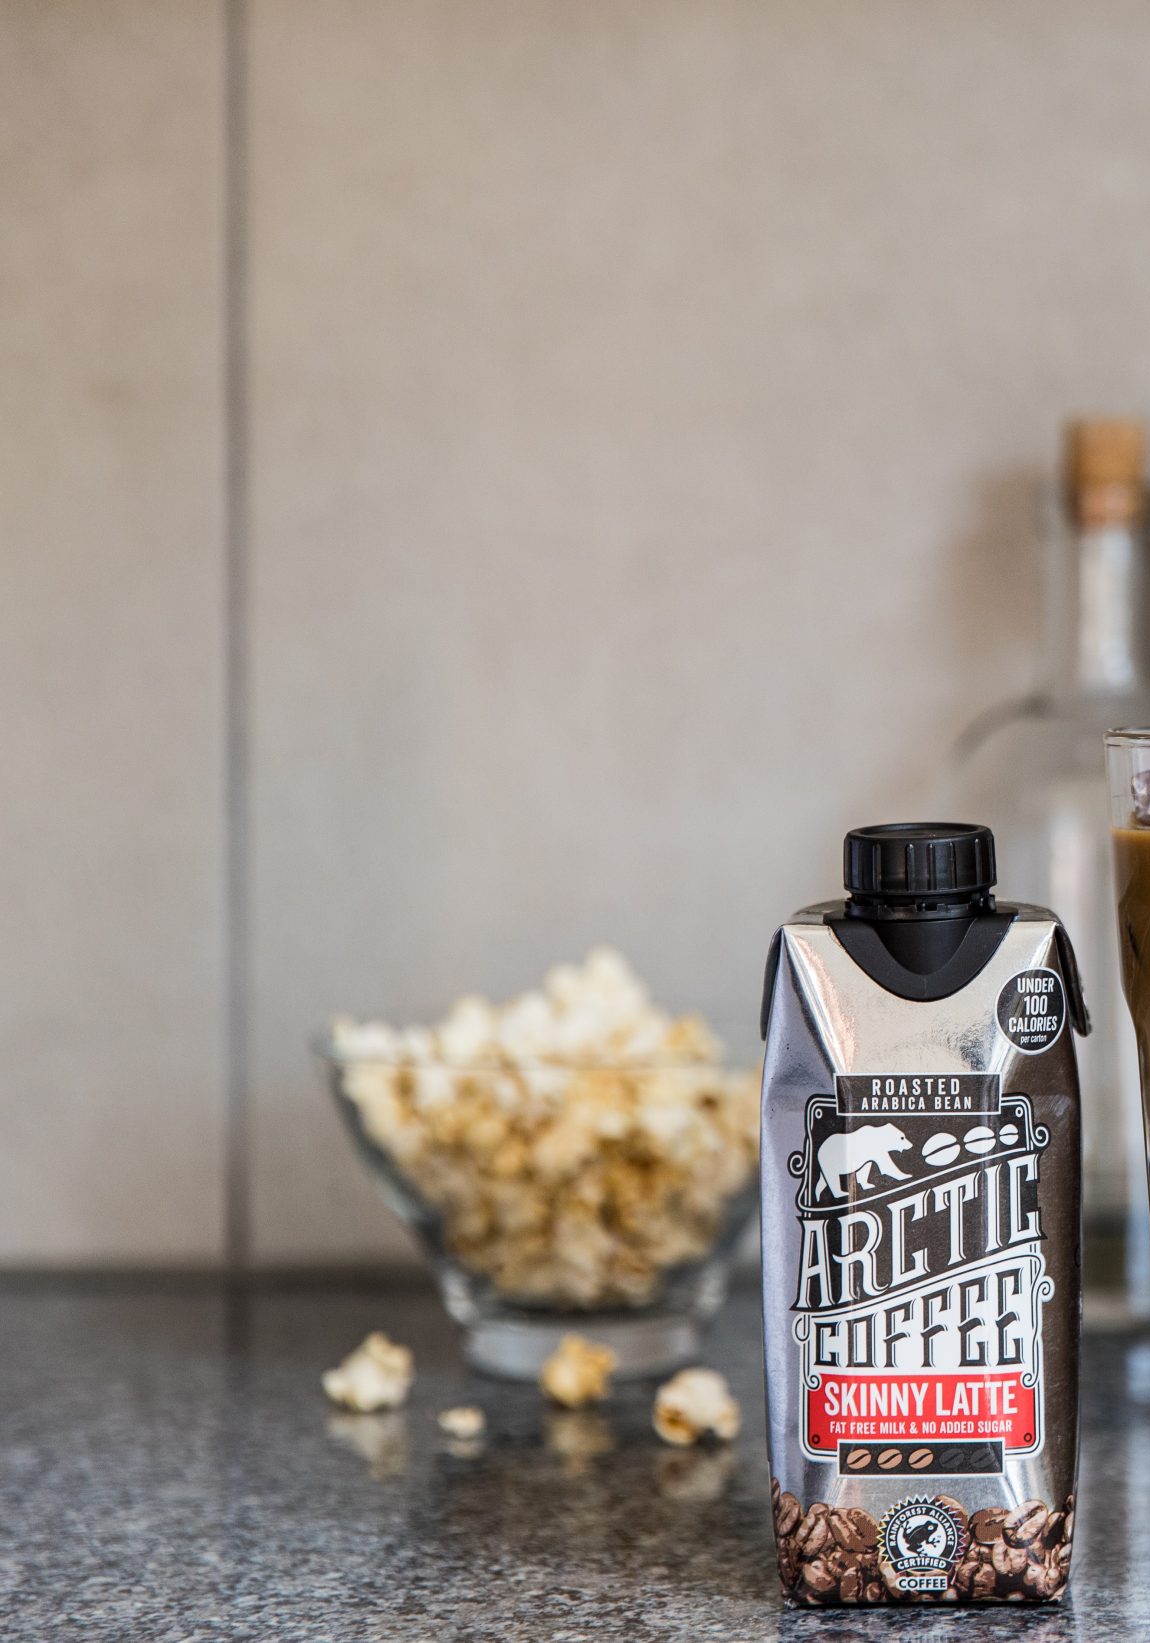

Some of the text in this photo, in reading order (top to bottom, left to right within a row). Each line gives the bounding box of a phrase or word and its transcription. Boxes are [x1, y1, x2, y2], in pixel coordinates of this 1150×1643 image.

[1017, 977, 1054, 993] UNDER
[1023, 995, 1048, 1015] 100
[1008, 1015, 1058, 1032] CALORIES
[1020, 1034, 1047, 1045] per carton
[872, 1078, 960, 1095] ROASTED
[861, 1096, 972, 1110] ARABICA BEAN
[796, 1152, 1043, 1309] ARCTIC
[813, 1266, 1028, 1368] COFFEE
[824, 1379, 1018, 1417] SKINNY LATTE
[829, 1420, 1013, 1434] FAT FREE MILK & NO ADDED SUGAR
[889, 1507, 955, 1547] RAINFOREST ALLIANCE
[897, 1557, 947, 1570] CERTIFIED
[898, 1578, 946, 1588] COFFEE
